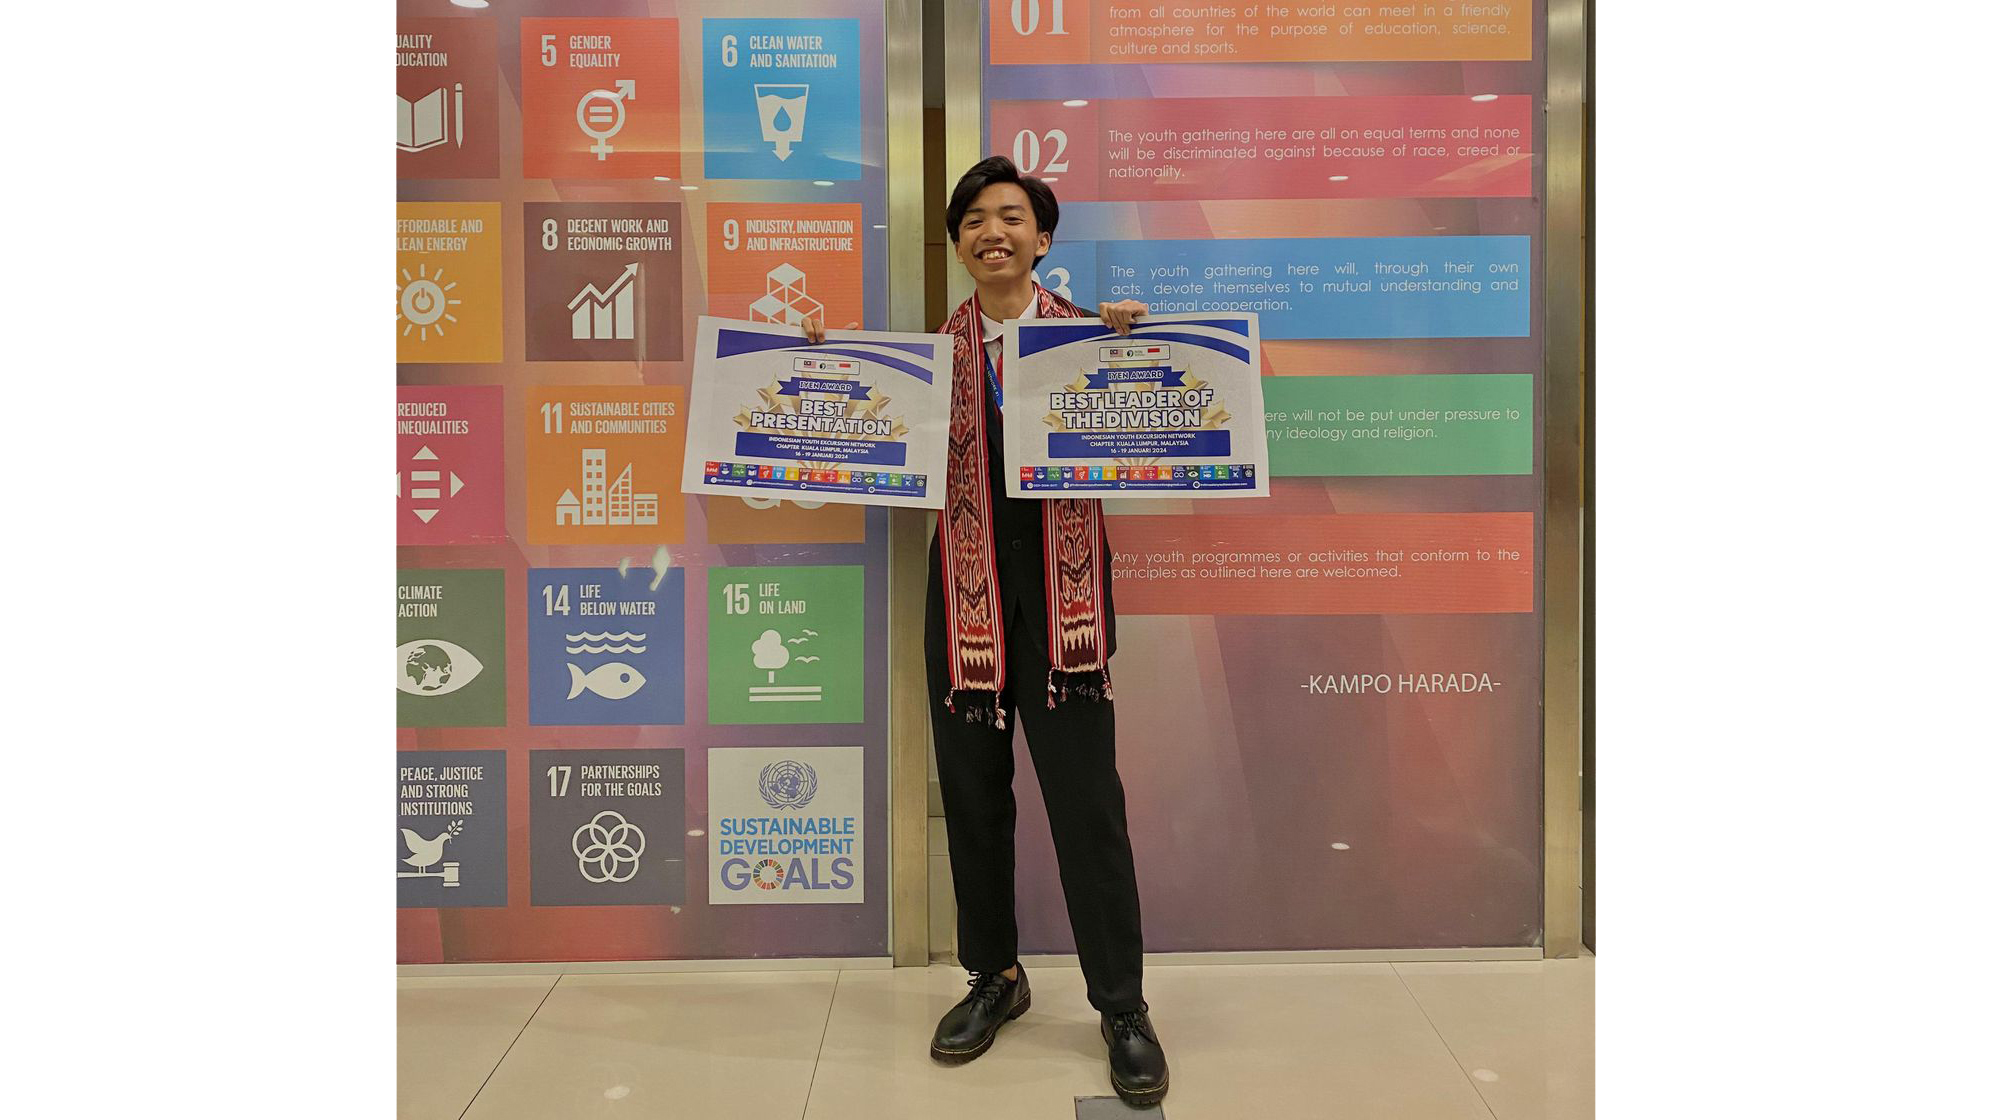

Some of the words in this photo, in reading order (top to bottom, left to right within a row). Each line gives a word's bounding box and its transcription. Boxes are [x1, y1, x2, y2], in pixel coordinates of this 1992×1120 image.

[1010, 0, 1070, 35] 01
[1109, 6, 1141, 18] from
[1149, 6, 1165, 18] all
[1172, 5, 1236, 18] countries
[1244, 5, 1259, 17] of
[1266, 5, 1289, 17] the
[1296, 4, 1335, 17] world
[1343, 7, 1371, 17] can
[1379, 5, 1415, 17] meet
[1424, 4, 1435, 16] in
[1461, 4, 1511, 19] friendly
[1109, 24, 1194, 39] atmosphere
[1206, 23, 1225, 36] for
[1236, 23, 1259, 35] the
[1270, 25, 1328, 38] purpose
[1339, 23, 1355, 35] of
[541, 34, 557, 67] 5
[569, 35, 612, 50] GENDER
[721, 34, 738, 67] 6
[750, 35, 784, 50] CLEAN
[786, 35, 823, 50] WATER
[1109, 42, 1157, 55] culture
[1162, 41, 1190, 54] and
[1193, 41, 1237, 57] sports.
[569, 53, 621, 68] EQUALITY
[750, 53, 772, 68] AND
[775, 53, 837, 68] SANITATION
[1108, 130, 1133, 142] The
[1137, 130, 1177, 145] youth
[1182, 128, 1250, 144] gathering
[1255, 128, 1287, 141] here
[1291, 129, 1315, 140] are
[1320, 127, 1336, 140] all
[1340, 129, 1359, 140] on
[1363, 127, 1404, 143] equal
[1409, 127, 1447, 139] terms
[1451, 126, 1479, 139] and
[1484, 127, 1520, 139] none
[1013, 129, 1069, 174] 02
[1108, 147, 1129, 160] will
[1137, 147, 1156, 160] be
[1163, 146, 1257, 160] discriminated
[1264, 145, 1315, 161] against
[1323, 145, 1385, 157] because
[1392, 144, 1406, 157] of
[1457, 144, 1499, 157] creed
[1506, 146, 1520, 157] or
[1108, 164, 1185, 180] nationality.
[460, 219, 483, 233] AND
[567, 219, 609, 233] DECENT
[611, 219, 643, 233] WORK
[646, 219, 669, 233] AND
[542, 218, 558, 251] 8
[723, 219, 740, 250] 9
[427, 237, 467, 251] ENERGY
[567, 236, 623, 251] ECONOMIC
[625, 236, 672, 251] GROWTH
[747, 237, 767, 251] AND
[770, 237, 853, 251] INFRASTRUCTURE
[1110, 265, 1135, 278] The
[1150, 264, 1189, 280] youth
[1204, 264, 1272, 279] gathering
[1287, 263, 1320, 275] here
[1374, 261, 1429, 277] through
[1443, 261, 1474, 273] their
[1488, 262, 1519, 273] own
[1111, 282, 1144, 296] acts,
[1153, 282, 1204, 295] devote
[1213, 281, 1290, 294] themselves
[1299, 281, 1314, 293] to
[1323, 280, 1372, 293] mutual
[1380, 279, 1481, 294] understanding
[1490, 278, 1519, 291] and
[1202, 299, 1293, 312] cooperation.
[1108, 371, 1129, 380] IYEN
[1130, 370, 1164, 379] AWARD
[1050, 392, 1102, 410] BEST
[1103, 390, 1182, 409] LEADER
[1183, 389, 1213, 408] OF
[397, 402, 447, 417] REDUCED
[570, 402, 640, 416] SUSTAINABLE
[642, 402, 675, 416] CITIES
[800, 399, 847, 417] BEST
[1292, 409, 1313, 421] will
[1318, 409, 1341, 421] not
[1346, 409, 1365, 421] be
[1370, 409, 1394, 424] put
[1398, 408, 1439, 421] under
[1444, 409, 1500, 423] pressure
[1506, 408, 1520, 420] to
[540, 402, 562, 434] 11
[751, 412, 891, 435] PRESENTATION
[1062, 411, 1107, 429] THE
[1106, 409, 1201, 429] DIVISION
[398, 420, 469, 435] INEQUALITIES
[570, 419, 592, 434] AND
[595, 419, 667, 434] COMMUNITIES
[1286, 426, 1347, 442] ideology
[1352, 426, 1379, 439] and
[1383, 426, 1438, 441] religion.
[1112, 551, 1138, 565] Any
[1145, 550, 1184, 565] youth
[1192, 552, 1281, 566] programmes
[1287, 552, 1301, 562] or
[1308, 550, 1369, 562] activities
[1376, 550, 1404, 562] that
[1411, 549, 1469, 561] conform
[1477, 549, 1491, 561] to
[1498, 548, 1521, 561] the
[1112, 566, 1177, 580] principles
[1180, 568, 1196, 578] as
[1200, 566, 1256, 578] outlined
[1260, 566, 1292, 578] here
[1296, 567, 1319, 578] are
[1323, 565, 1402, 578] welcomed.
[398, 585, 442, 600] CLIMATE
[580, 584, 601, 599] LIFE
[759, 583, 780, 597] LIFE
[542, 585, 570, 616] 14
[723, 583, 750, 615] 15
[759, 600, 774, 614] ON
[778, 600, 806, 614] LAND
[398, 603, 438, 617] ACTION
[580, 602, 616, 616] BELOW
[619, 602, 655, 616] WATER
[1300, 674, 1392, 694] -KAMPO
[1398, 672, 1501, 693] HARADA-
[400, 767, 438, 782] PEACE,
[440, 766, 484, 781] JUSTICE
[581, 765, 660, 779] PARTNERSHIPS
[547, 765, 572, 797] 17
[400, 784, 423, 798] AND
[426, 784, 469, 798] STRONG
[581, 782, 601, 797] FOR
[604, 782, 624, 797] THE
[627, 782, 662, 797] GOALS
[400, 801, 473, 816] INSTITUTIONS
[720, 817, 855, 835] SUSTAINABLE
[720, 838, 853, 855] DEVELOPMENT
[720, 857, 854, 891] GOALS
